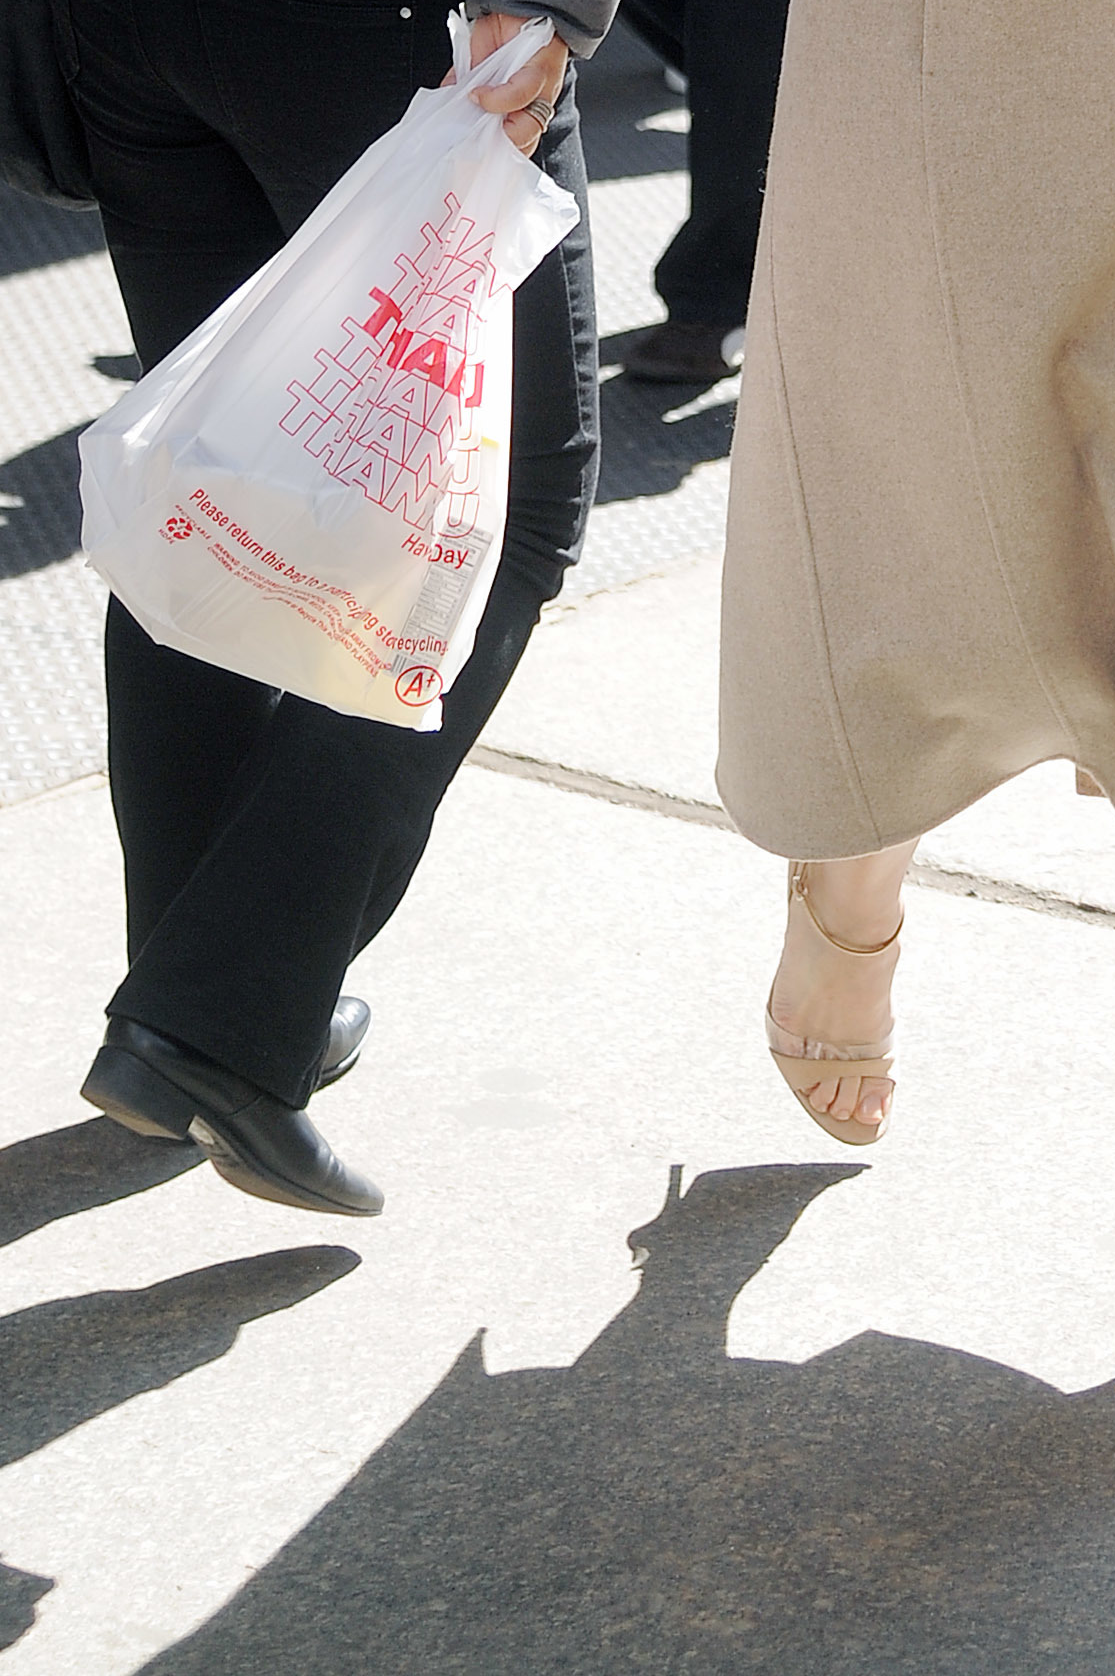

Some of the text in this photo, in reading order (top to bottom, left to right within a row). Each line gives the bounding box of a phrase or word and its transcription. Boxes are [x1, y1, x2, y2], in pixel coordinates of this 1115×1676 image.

[188, 488, 229, 527] Please
[225, 522, 264, 557] return
[260, 550, 286, 571] this
[283, 565, 307, 584] bag
